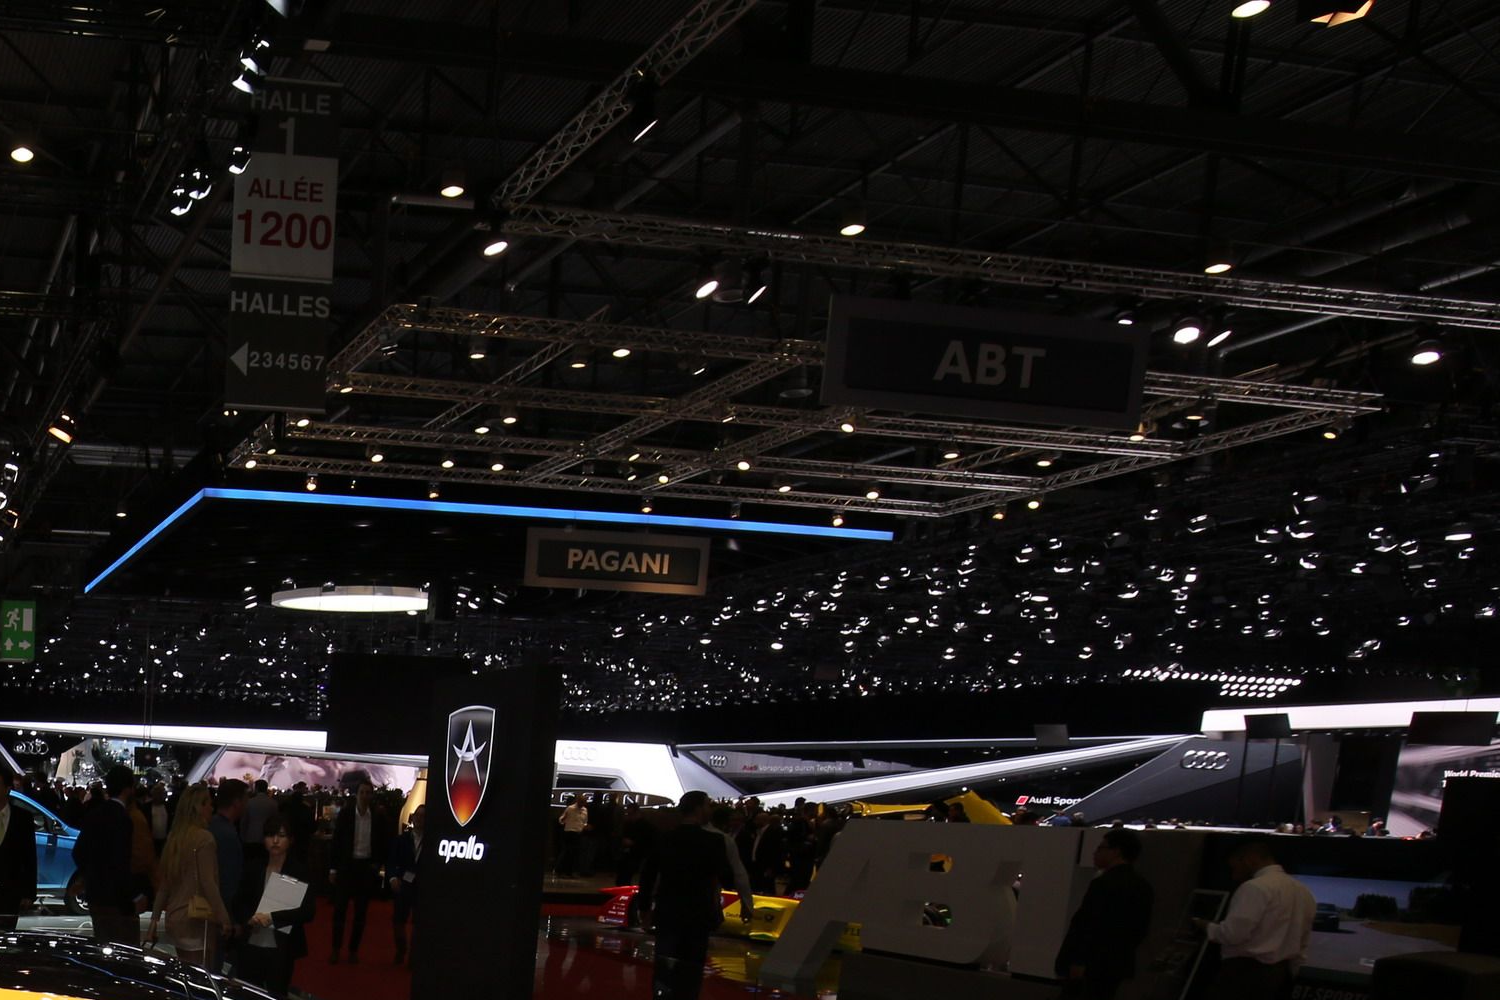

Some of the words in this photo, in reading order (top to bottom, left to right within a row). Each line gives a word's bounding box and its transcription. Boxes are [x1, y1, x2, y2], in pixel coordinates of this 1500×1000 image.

[251, 88, 331, 115] HALLE
[278, 116, 296, 155] 1
[248, 176, 324, 203] ALLÉE
[237, 209, 332, 250] 1200
[230, 290, 331, 319] HALLES
[931, 339, 1047, 389] ABT
[566, 547, 671, 575] PAGANI
[1444, 770, 1468, 778] World
[1469, 770, 1500, 778] Premie
[1028, 796, 1052, 804] Audi
[438, 834, 485, 864] apollo
